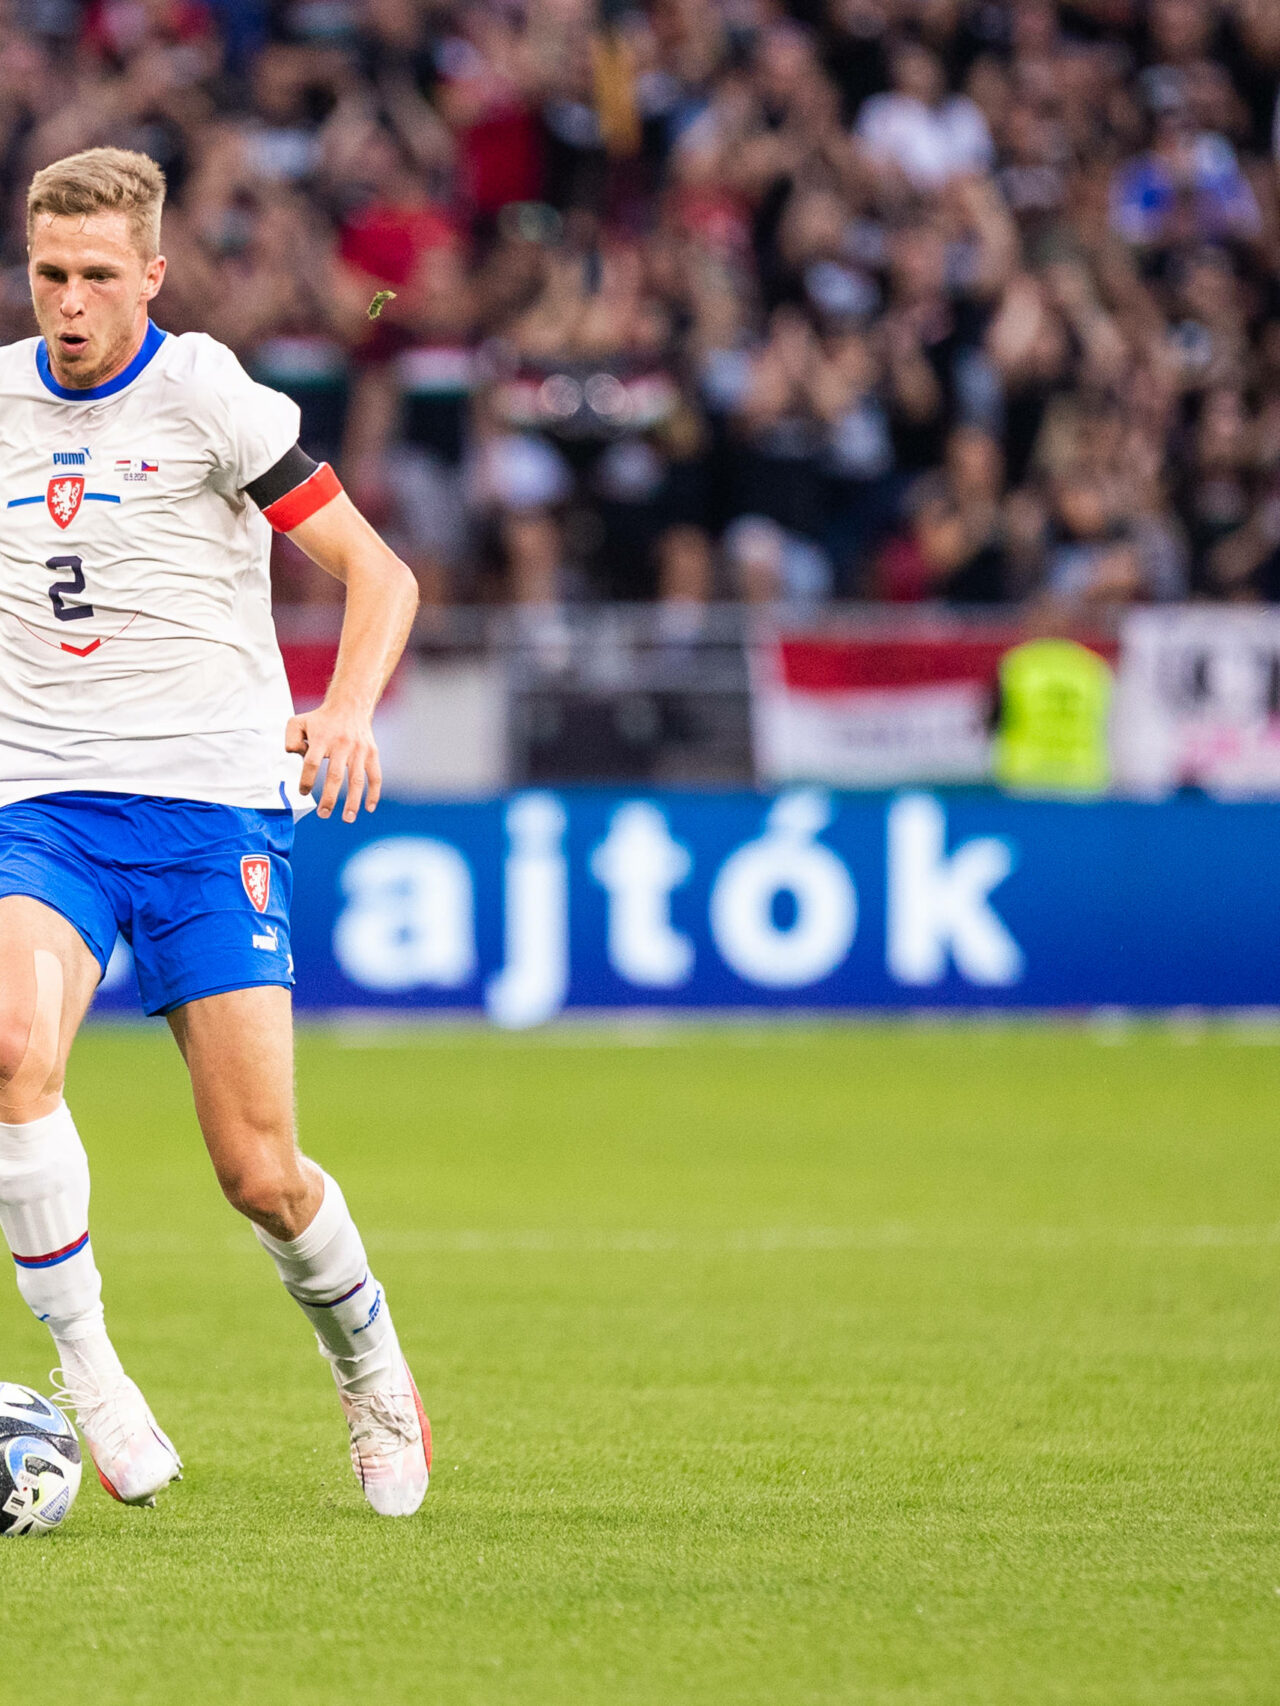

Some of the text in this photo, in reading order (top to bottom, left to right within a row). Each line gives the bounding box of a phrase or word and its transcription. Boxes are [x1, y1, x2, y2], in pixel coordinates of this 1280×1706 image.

[53, 452, 86, 465] PUMA
[45, 555, 94, 622] 2
[332, 787, 1024, 1030] ajtók
